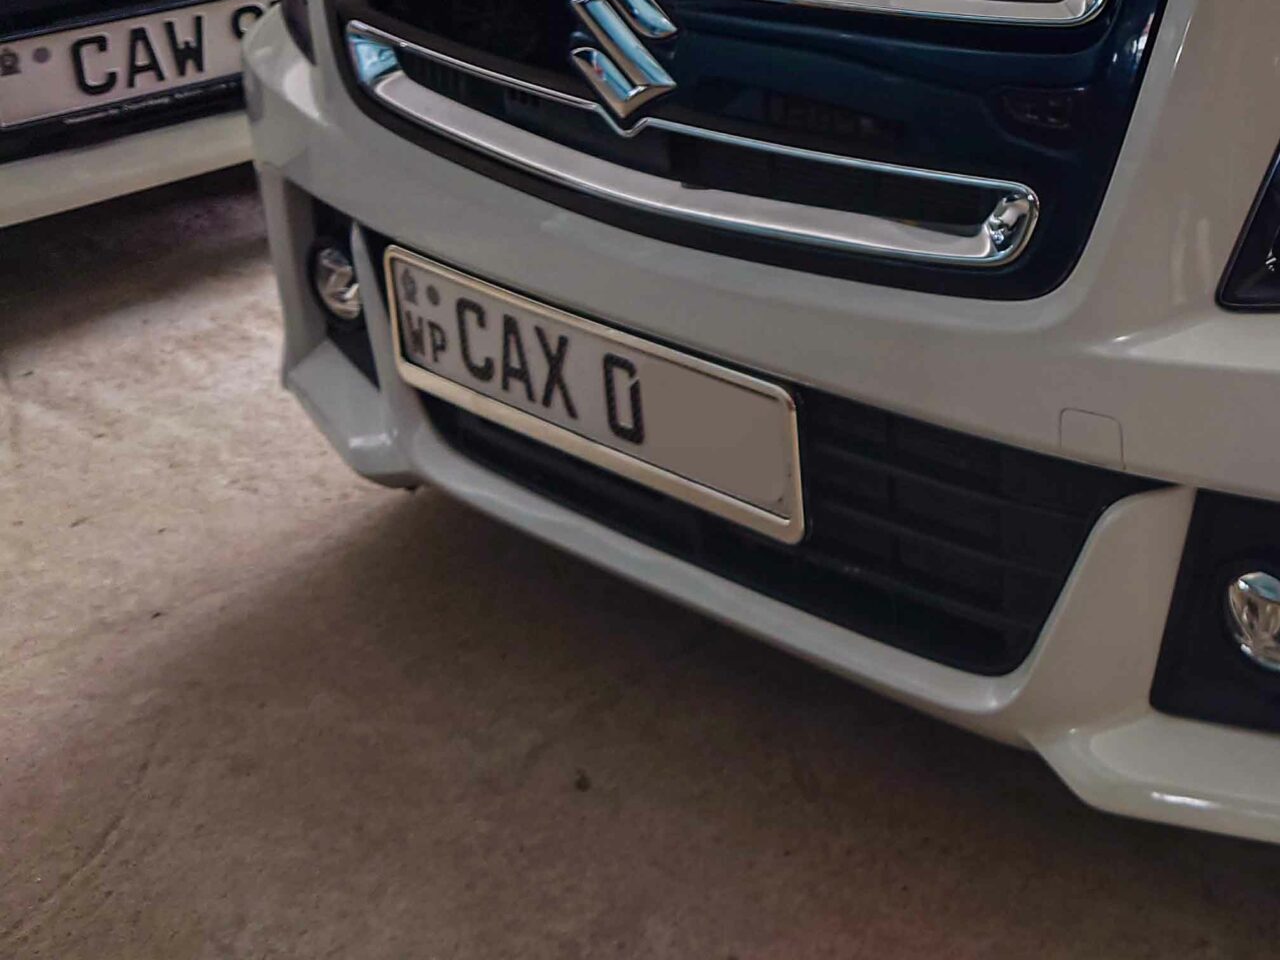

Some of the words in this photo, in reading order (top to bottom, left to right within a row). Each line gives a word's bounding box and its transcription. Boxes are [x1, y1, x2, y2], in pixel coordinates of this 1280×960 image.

[71, 15, 205, 96] CAW
[405, 309, 447, 363] WP
[456, 297, 579, 421] CAX
